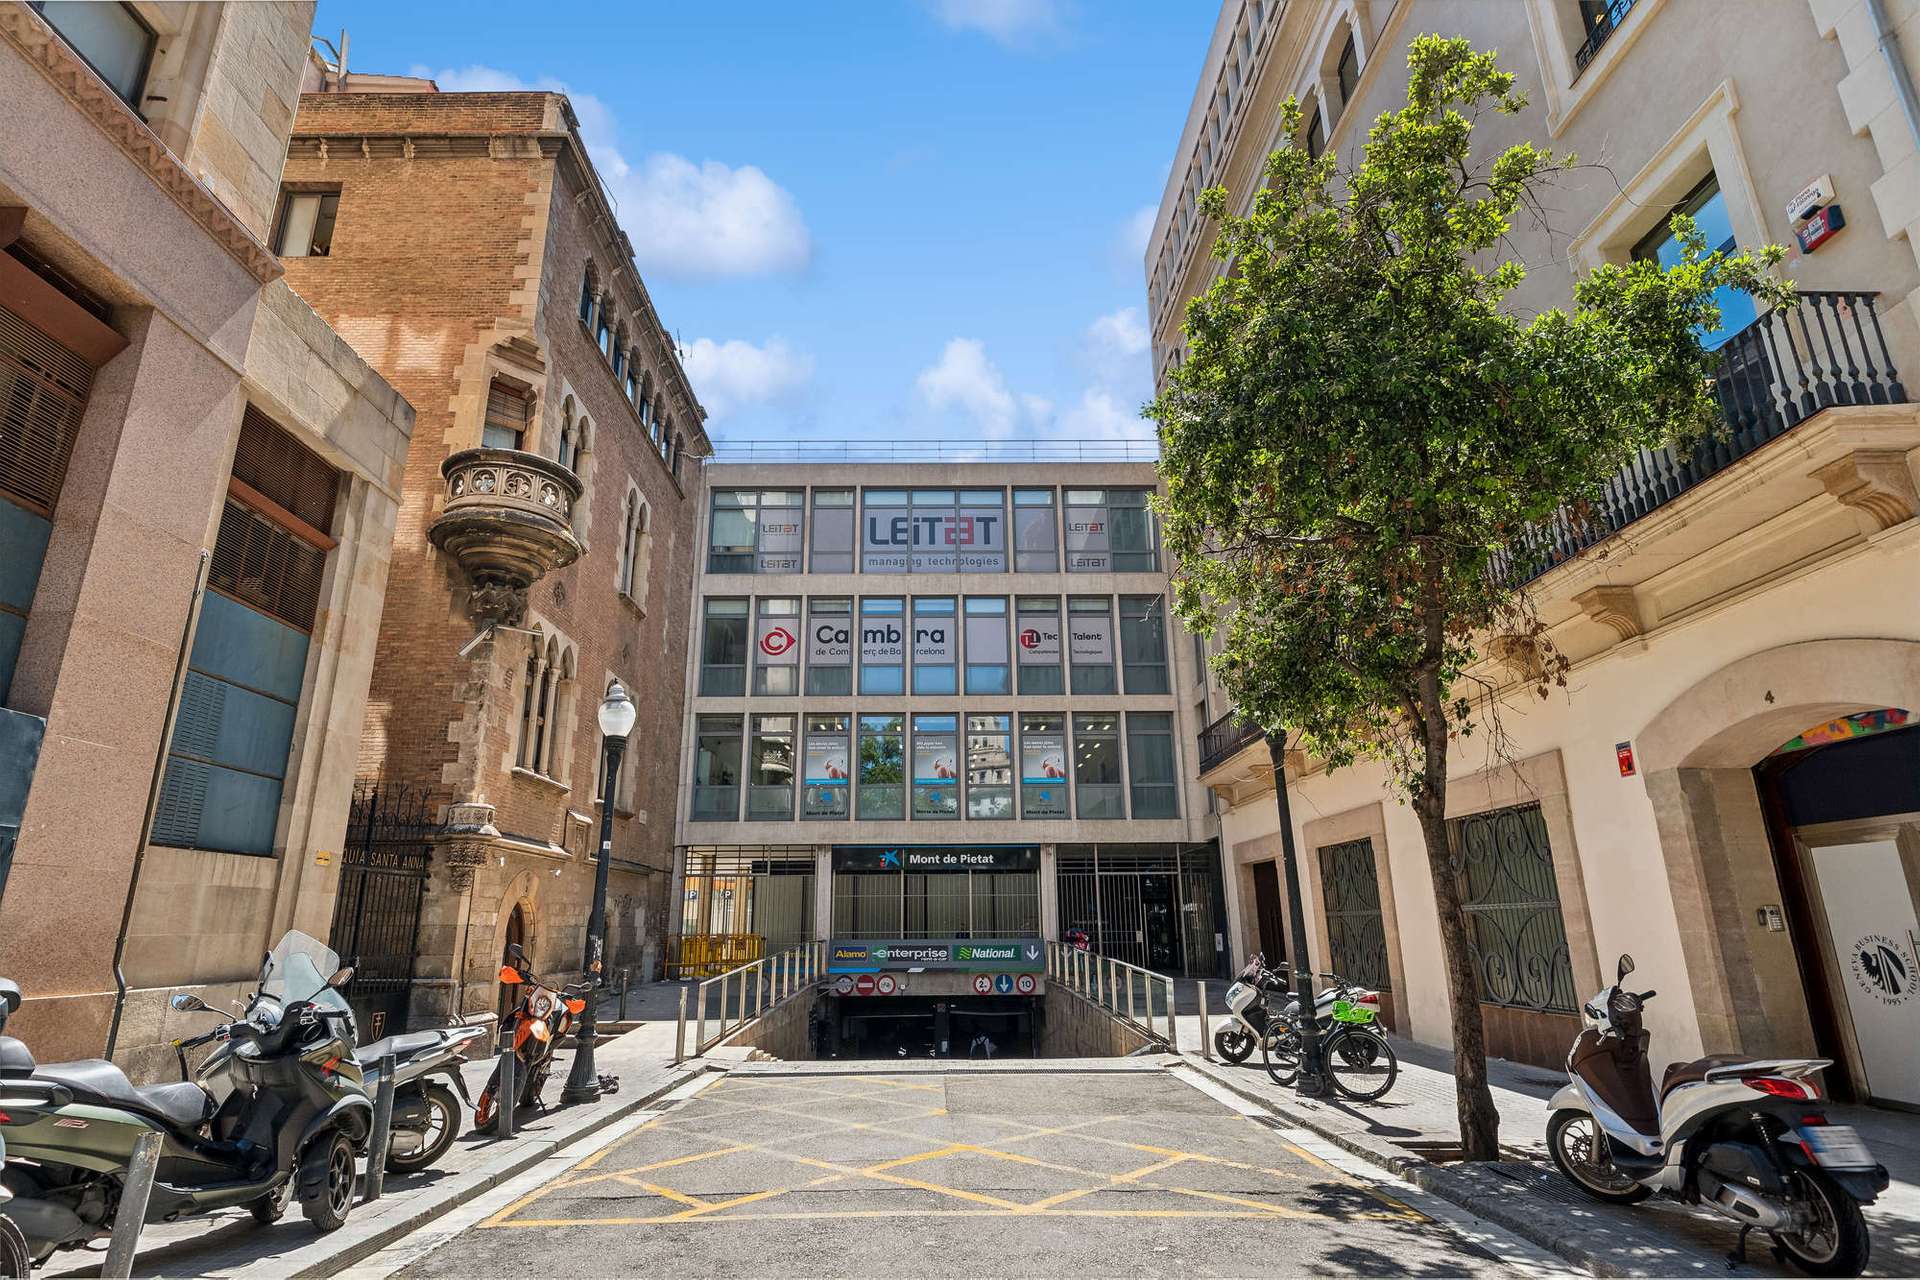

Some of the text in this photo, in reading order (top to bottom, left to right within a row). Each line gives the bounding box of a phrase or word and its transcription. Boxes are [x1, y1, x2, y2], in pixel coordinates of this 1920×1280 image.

[928, 556, 999, 568] technologies
[1043, 632, 1102, 641] Tec Talent
[815, 647, 826, 656] de
[878, 647, 889, 656] de
[370, 851, 398, 868] SANTA
[402, 856, 424, 871] ANNA
[909, 853, 994, 864] Mont de Pietat
[835, 950, 866, 958] Alamo
[875, 948, 948, 960] enterprise
[972, 947, 1014, 958] National
[1854, 934, 1899, 951] BUSINESS
[1900, 952, 1917, 995] SCHOOL
